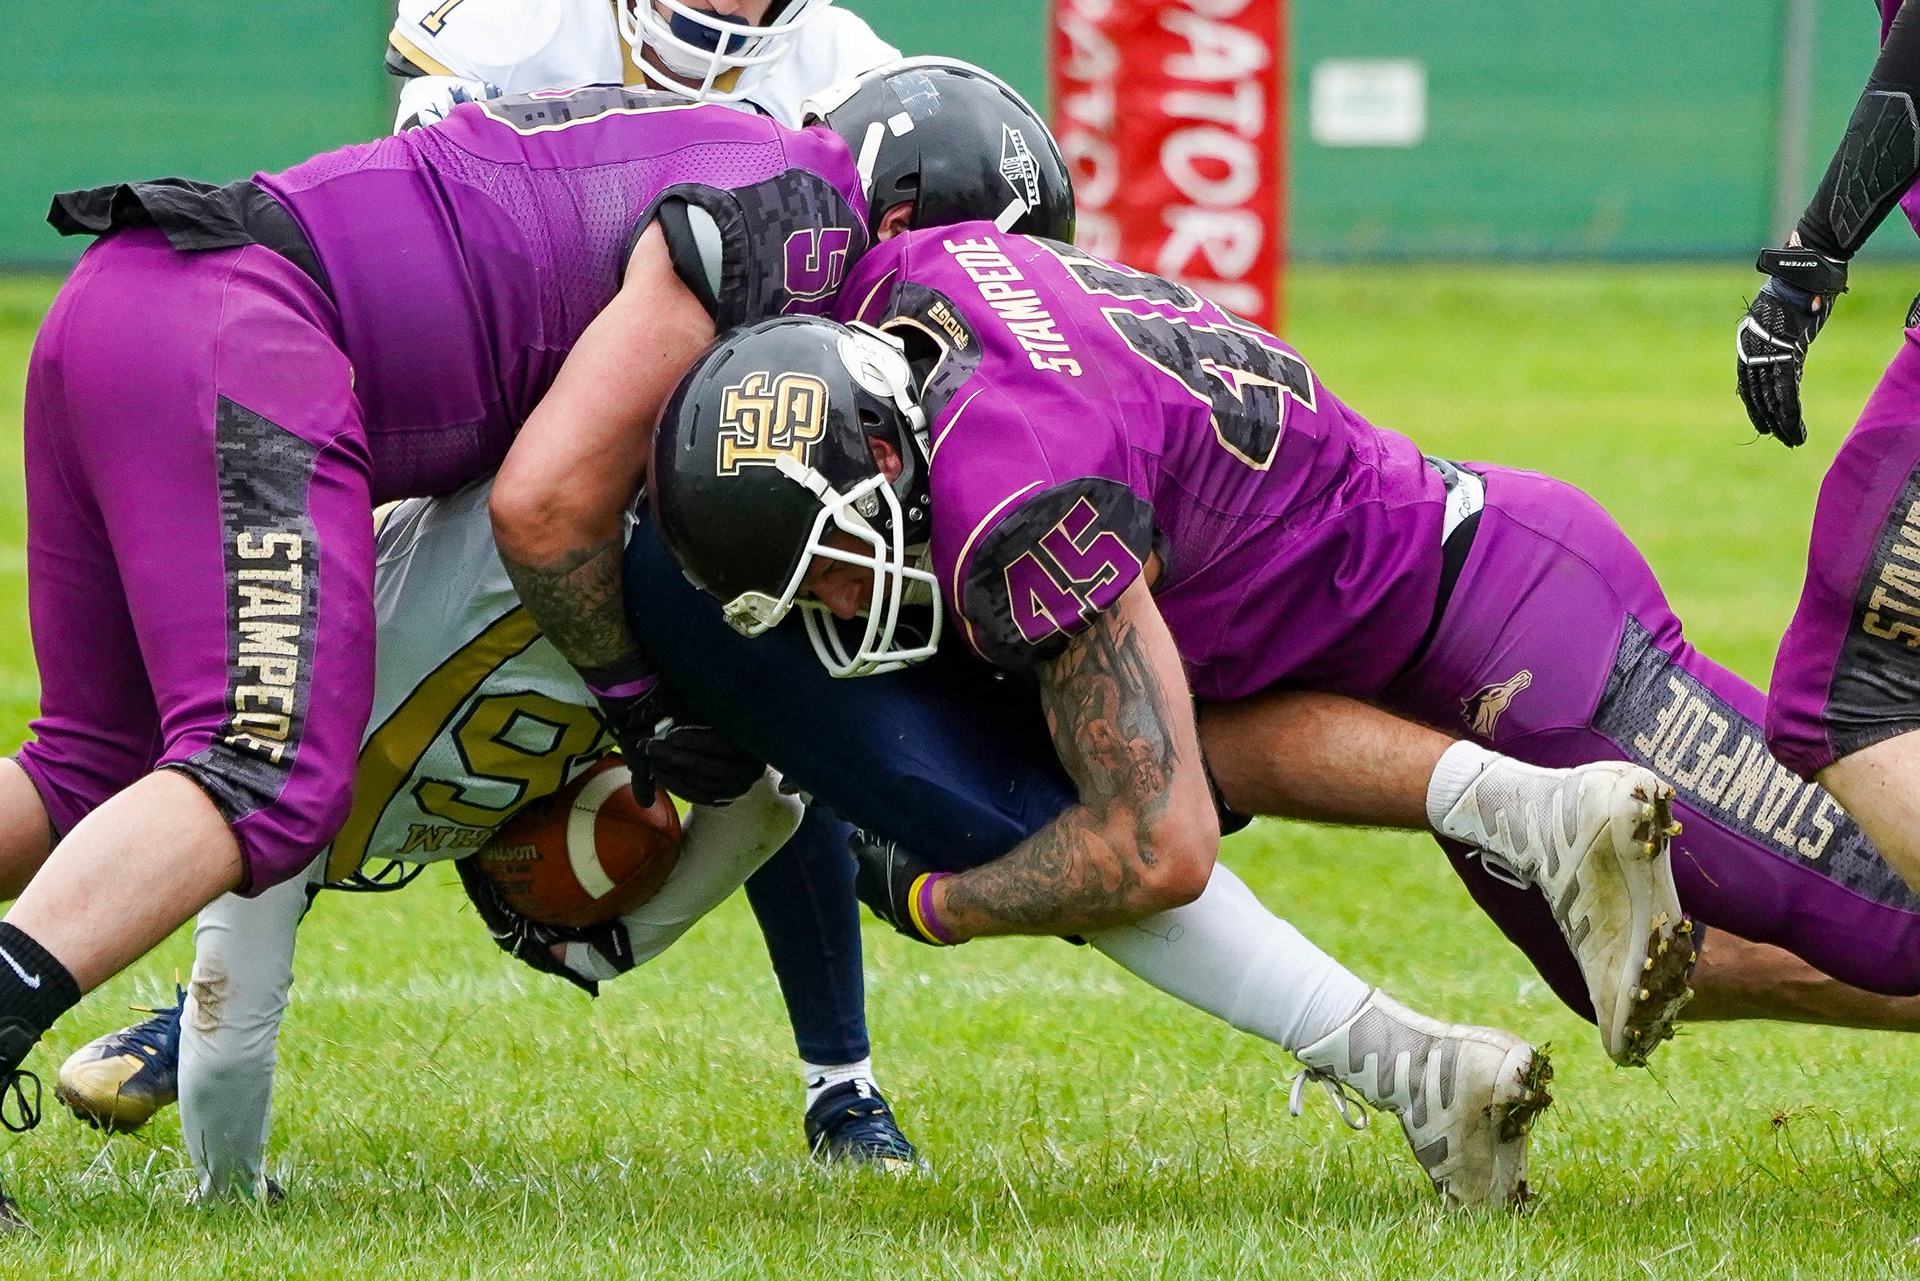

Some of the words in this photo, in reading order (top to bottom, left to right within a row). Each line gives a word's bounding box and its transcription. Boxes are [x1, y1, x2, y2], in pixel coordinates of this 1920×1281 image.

[1003, 157, 1025, 181] BOYS
[1011, 131, 1027, 157] THE
[1022, 160, 1039, 203] BEEFY
[1158, 0, 1270, 316] ATOR
[943, 236, 1083, 377] STAMPEDE
[1004, 496, 1143, 646] 45
[224, 531, 303, 764] STAMPEDE
[1633, 675, 1845, 860] STAMPEDE
